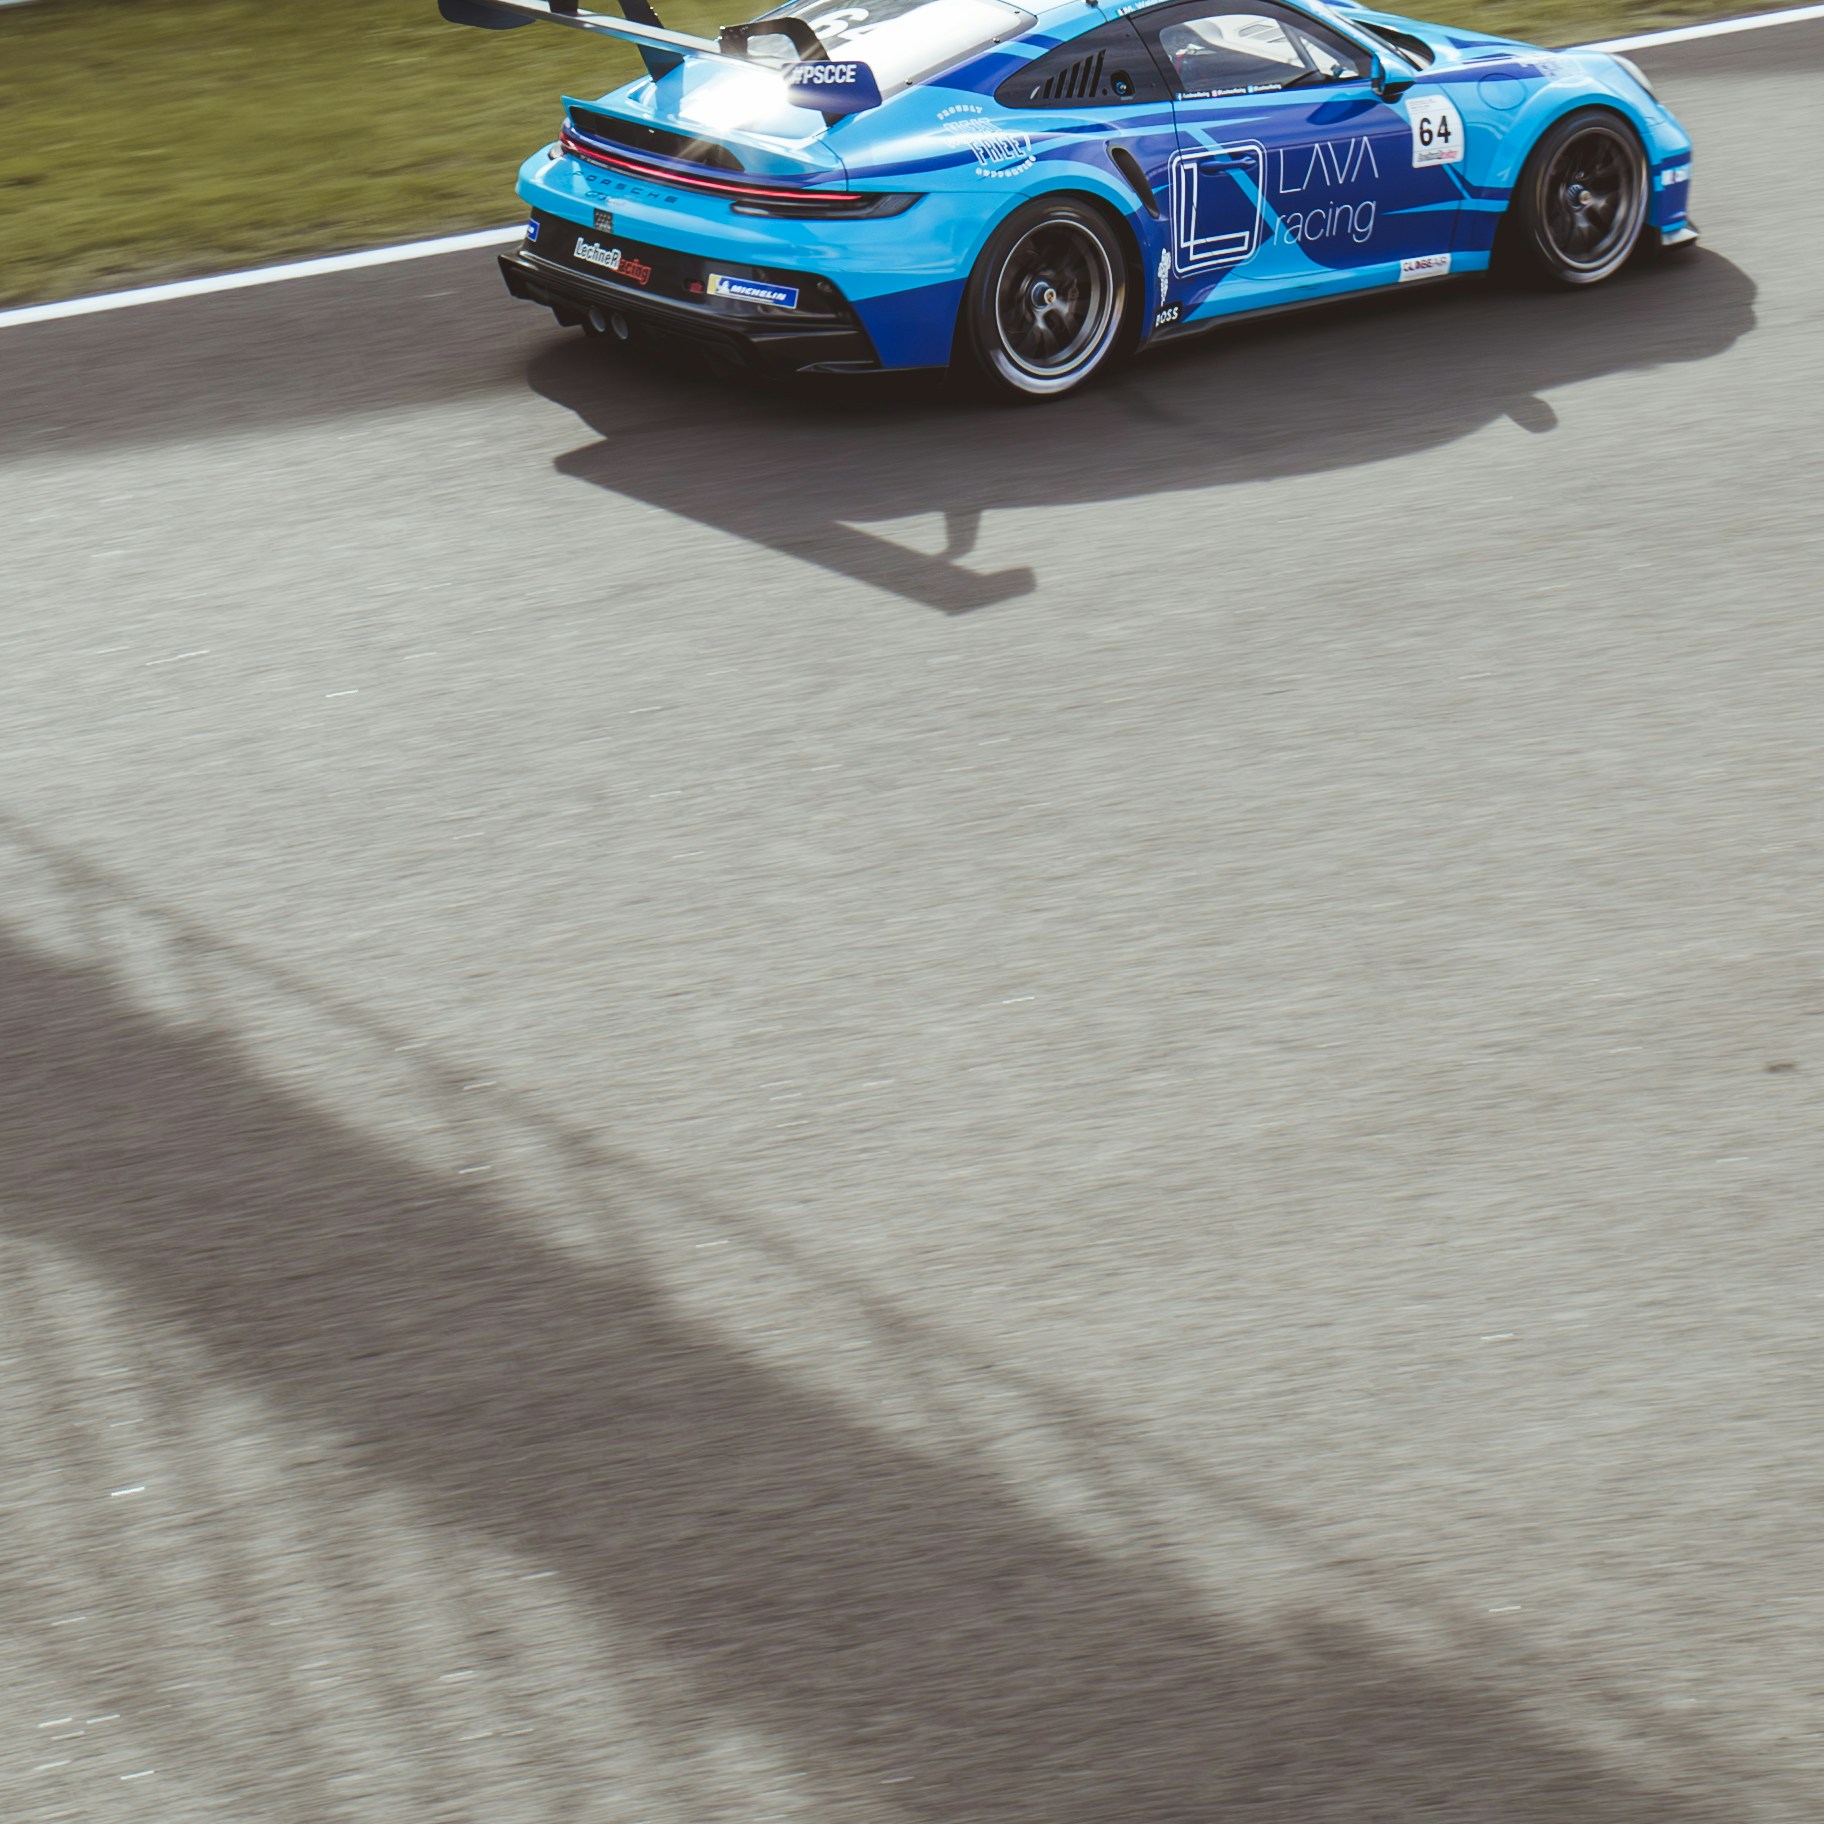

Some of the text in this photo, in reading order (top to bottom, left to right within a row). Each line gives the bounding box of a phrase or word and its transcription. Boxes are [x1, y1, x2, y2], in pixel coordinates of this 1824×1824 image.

[791, 64, 857, 84] #PSCCE
[1420, 115, 1452, 147] 64
[1280, 136, 1379, 194] LAVA
[572, 170, 679, 204] PORSCHE
[1273, 200, 1377, 245] racing
[730, 284, 787, 301] MICHELIN
